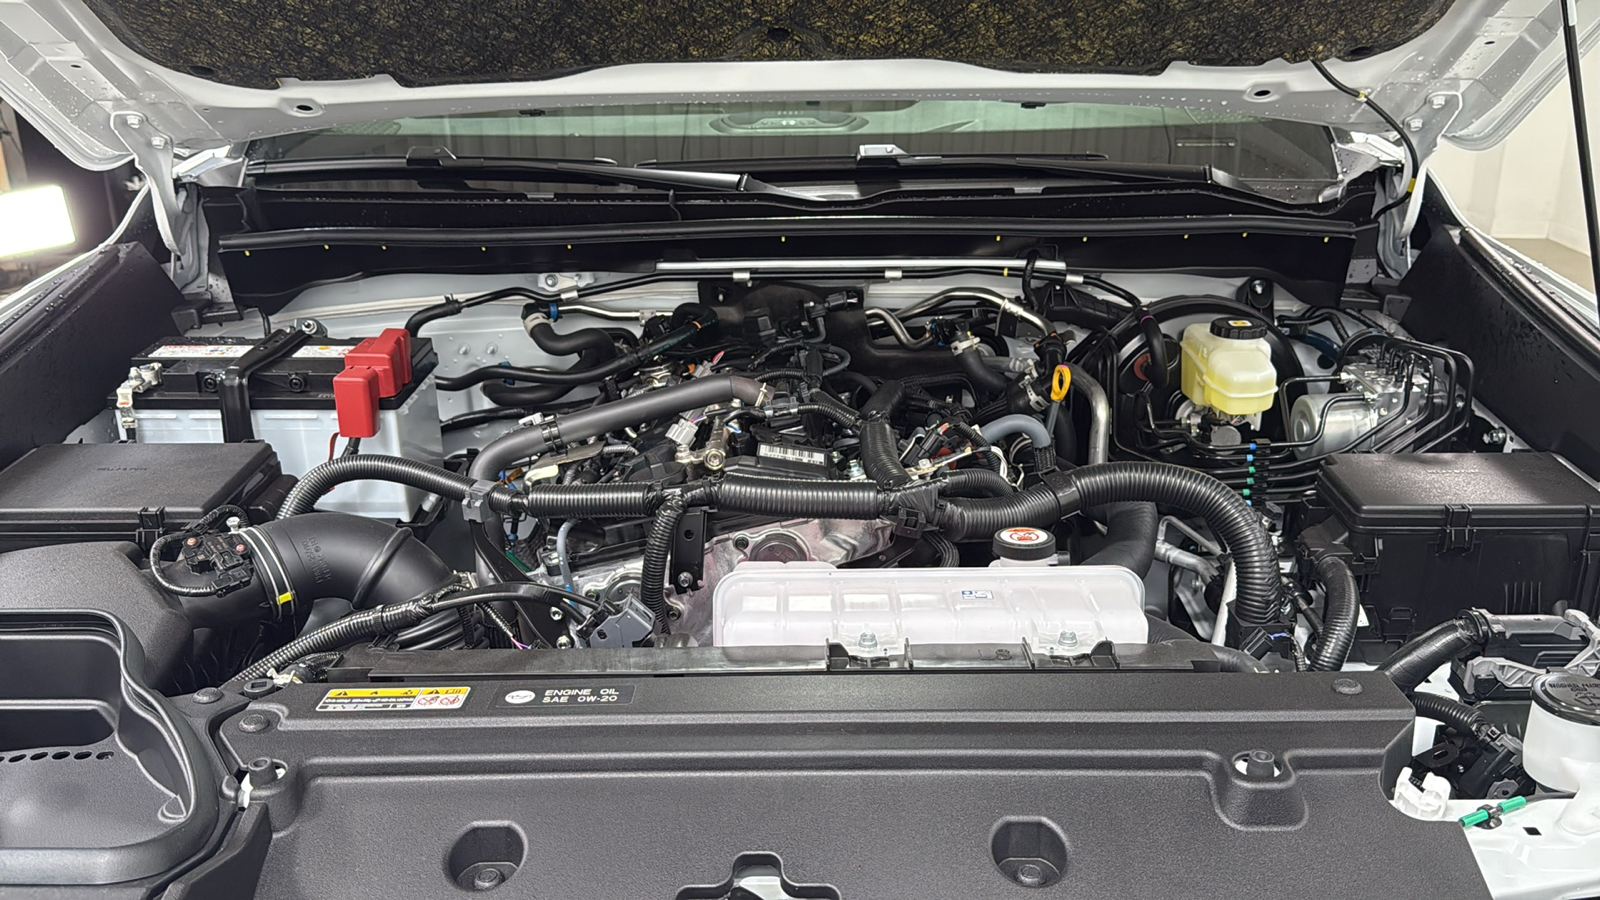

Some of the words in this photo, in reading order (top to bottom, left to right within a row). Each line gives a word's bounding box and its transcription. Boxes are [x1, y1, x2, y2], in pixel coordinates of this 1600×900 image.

[544, 688, 593, 696] ENGINE
[542, 696, 570, 704] SAE
[577, 695, 618, 703] 0W-20
